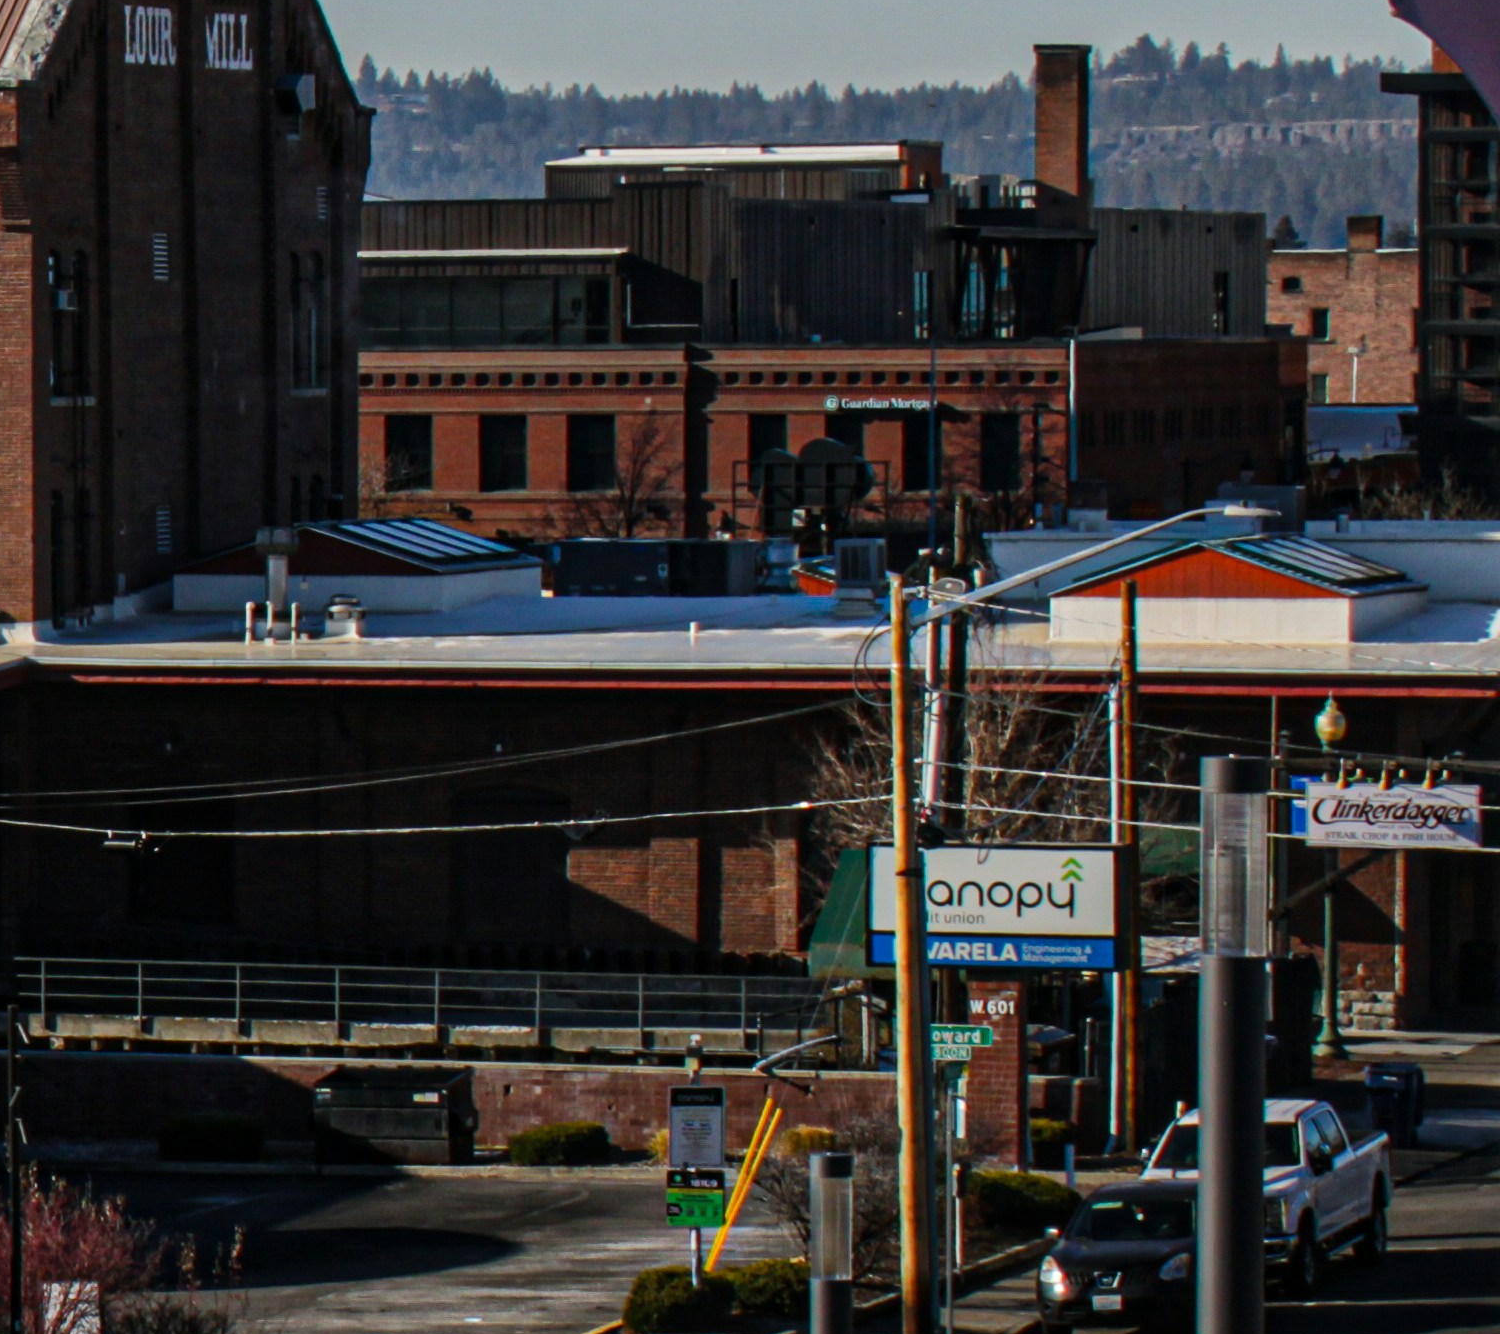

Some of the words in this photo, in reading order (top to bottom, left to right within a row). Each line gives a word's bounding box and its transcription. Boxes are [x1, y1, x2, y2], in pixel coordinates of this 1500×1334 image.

[124, 4, 177, 66] LOUR
[841, 397, 890, 409] Guardian
[1362, 832, 1389, 841] CHOP
[1402, 833, 1424, 842] FISH
[1427, 833, 1458, 842] HOUSE
[926, 880, 1075, 918] anopy
[944, 910, 986, 925] union
[1022, 942, 1083, 956] Engineering
[1022, 952, 1089, 965] Management
[987, 999, 1015, 1015] 601
[932, 1029, 982, 1044] oward
